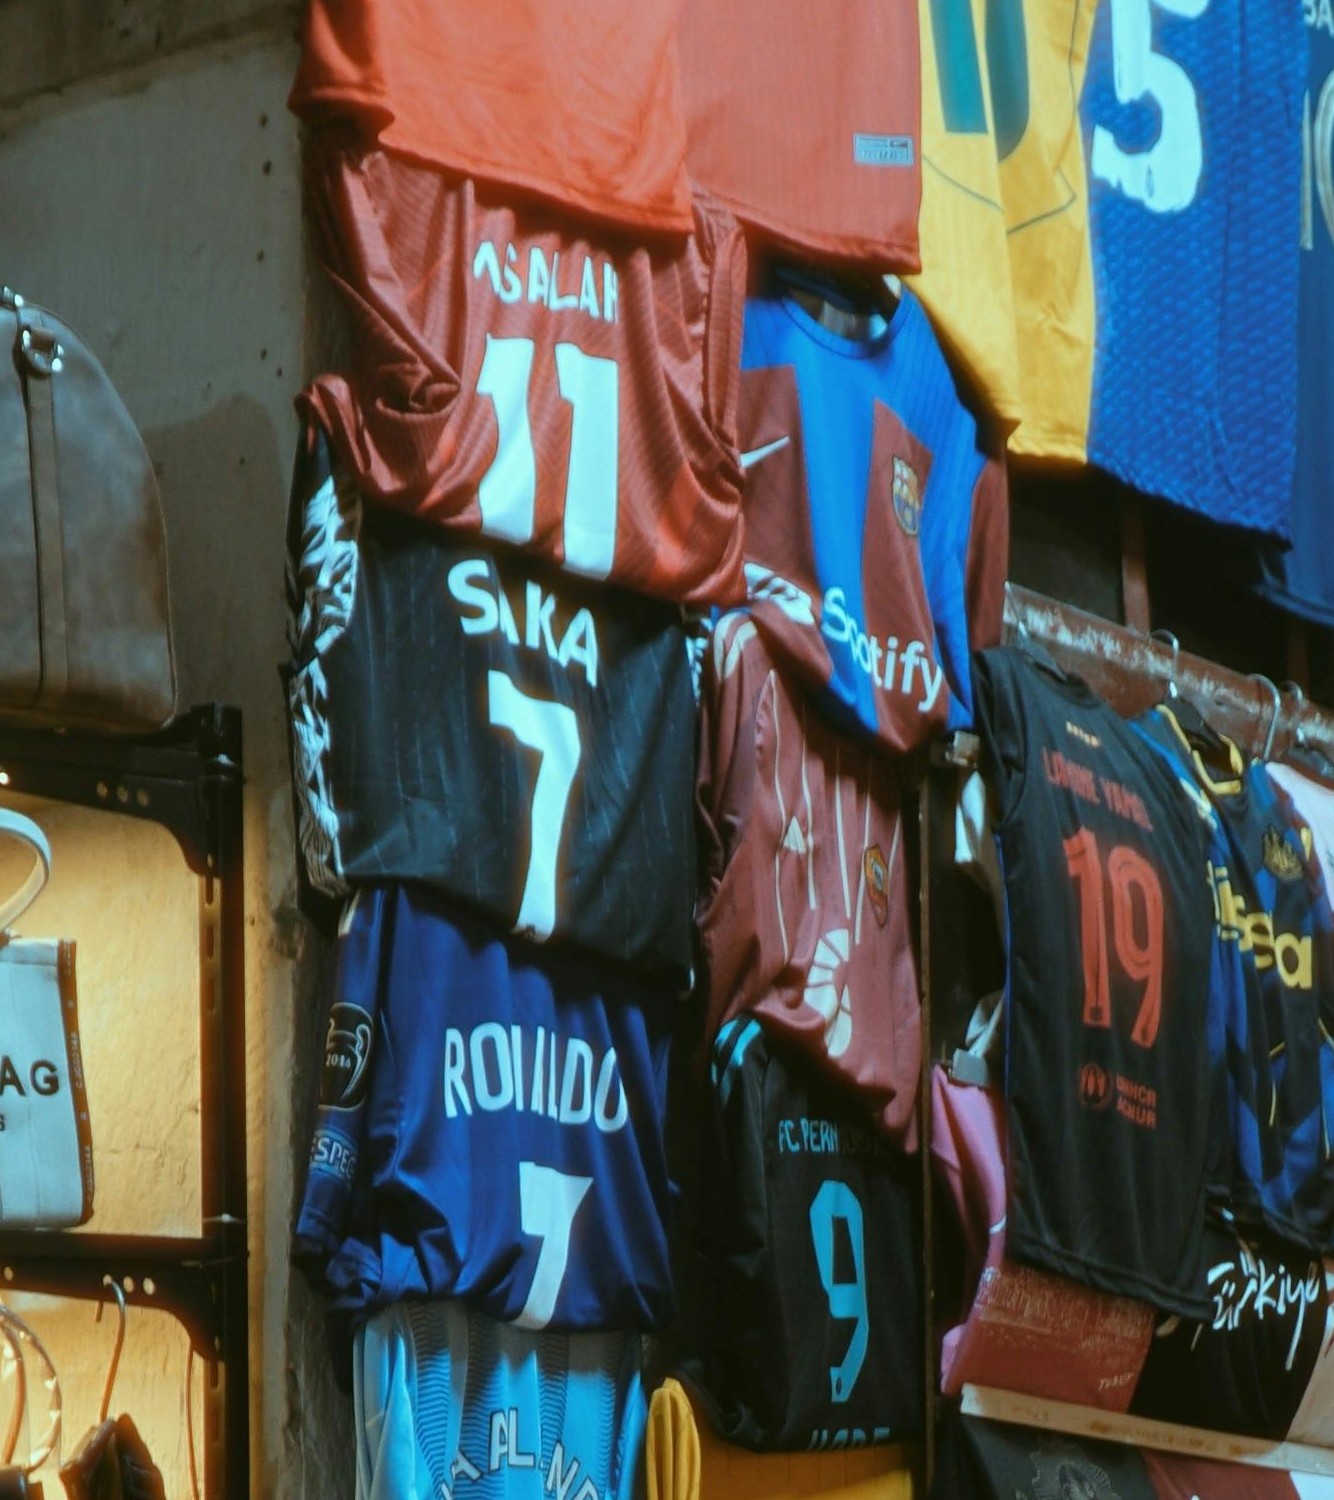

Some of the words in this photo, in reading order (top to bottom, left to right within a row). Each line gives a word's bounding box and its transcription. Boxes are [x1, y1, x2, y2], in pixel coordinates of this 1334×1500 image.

[476, 332, 619, 580] 11
[487, 668, 580, 943] 7
[1062, 824, 1165, 1050] 19
[509, 1160, 593, 1332] 7
[808, 1179, 869, 1403] 9
